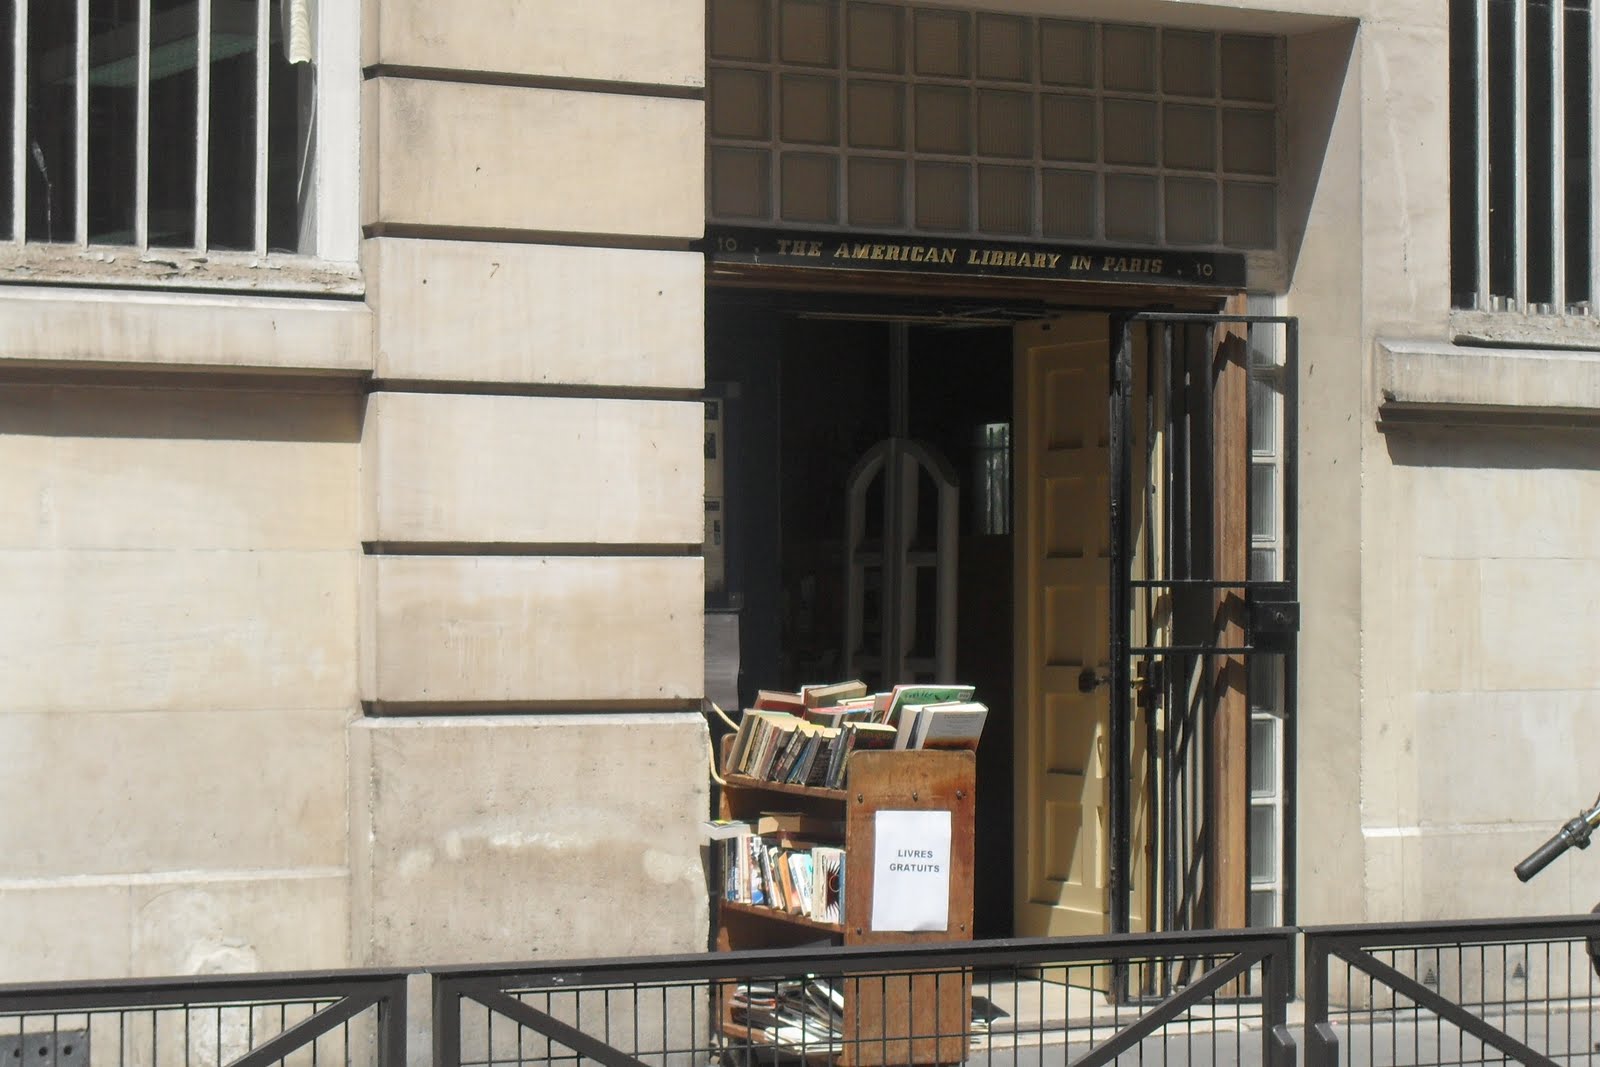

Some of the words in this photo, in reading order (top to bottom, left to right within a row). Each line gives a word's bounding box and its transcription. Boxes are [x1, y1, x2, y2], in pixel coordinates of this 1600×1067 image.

[717, 236, 737, 252] 10
[777, 239, 823, 257] THE
[834, 242, 956, 263] AMERICAN
[967, 249, 1061, 269] LIBRARY
[1070, 255, 1092, 271] IN
[1102, 256, 1163, 273] PARIS
[1196, 263, 1213, 277] 10
[897, 849, 934, 859] LIVRES
[889, 863, 940, 873] GRATUITS
